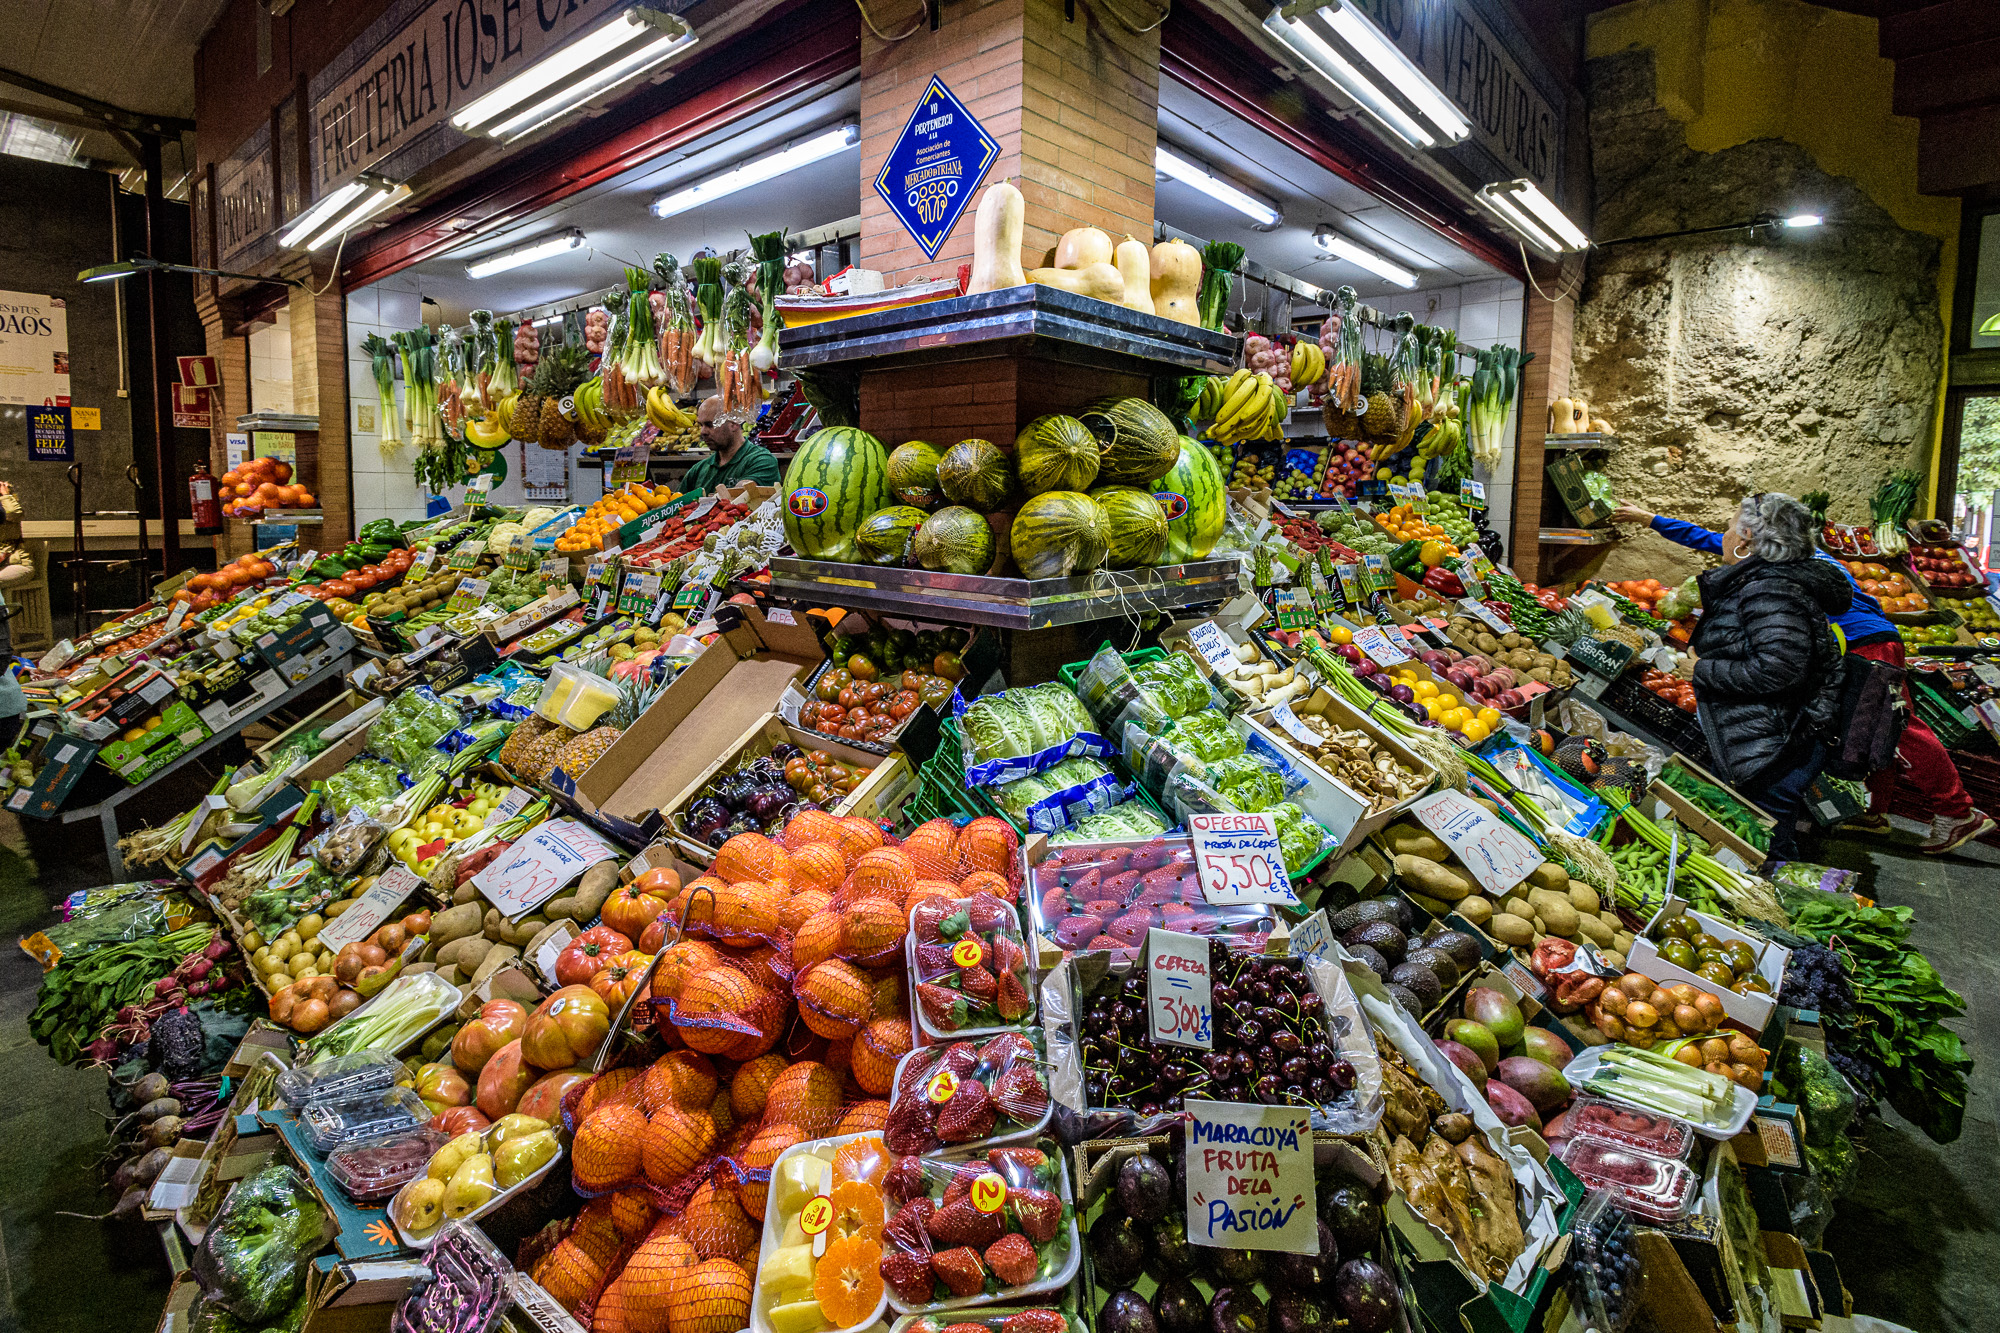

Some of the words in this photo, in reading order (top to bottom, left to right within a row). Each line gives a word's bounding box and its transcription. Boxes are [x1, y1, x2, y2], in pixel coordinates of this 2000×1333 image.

[319, 28, 438, 185] FRUTERIA
[929, 102, 938, 116] YO
[914, 113, 953, 136] PERTENEZCO
[932, 131, 938, 140] LA
[915, 141, 943, 156] Asociación
[943, 139, 951, 148] de
[915, 149, 951, 165] Comerciantes
[904, 166, 933, 191] MERCADO
[937, 160, 963, 179] TRIANA
[36, 438, 66, 449] FELIZ
[641, 512, 660, 528] AJOS
[661, 501, 684, 519] ROJAS
[1353, 628, 1382, 644] OFERTA
[1578, 640, 1620, 670] SERFRAN
[1420, 797, 1472, 830] OFERTA
[1193, 815, 1271, 836] OFERTA
[547, 820, 608, 868] OFERTA
[378, 869, 419, 897] OFERTA
[960, 943, 976, 961] 2
[1154, 954, 1208, 977] CEREZA
[935, 1079, 954, 1098] 2
[1203, 1148, 1280, 1179] FRUTA
[978, 1180, 1000, 1201] 2
